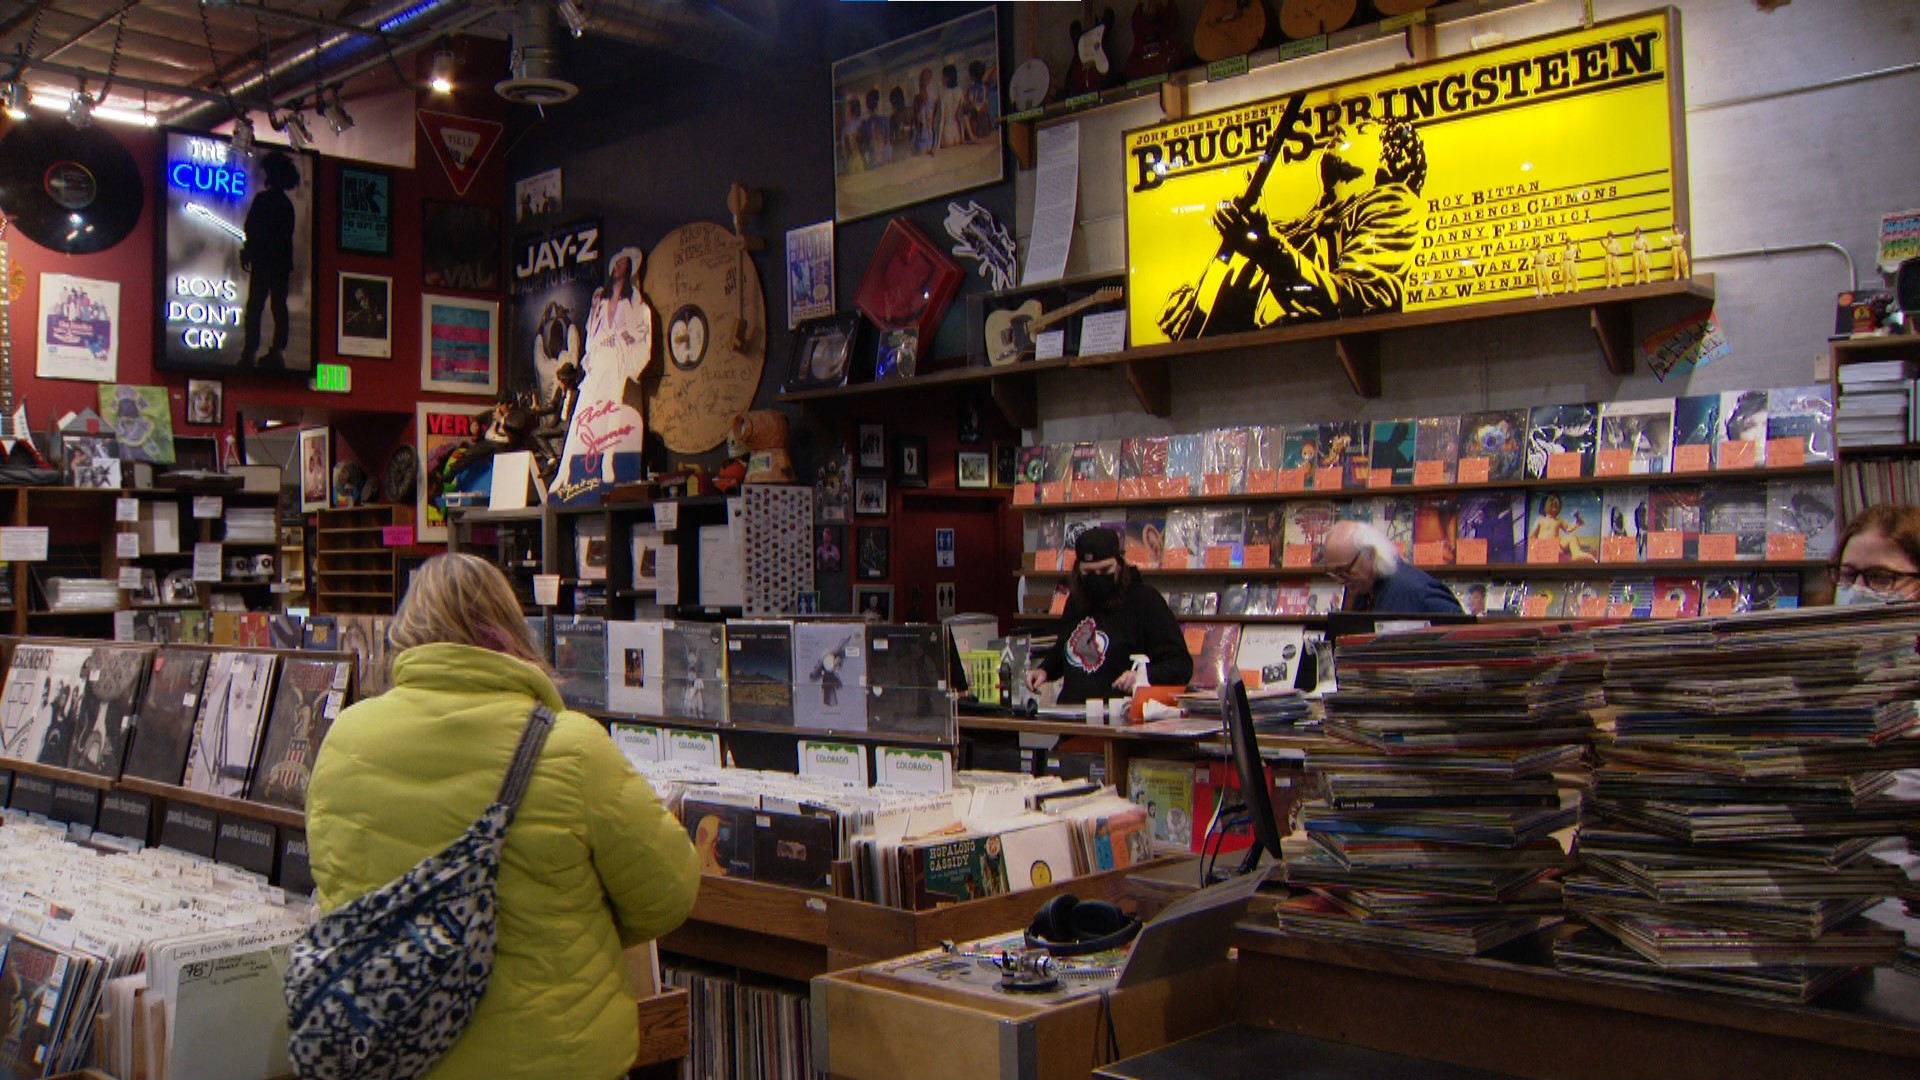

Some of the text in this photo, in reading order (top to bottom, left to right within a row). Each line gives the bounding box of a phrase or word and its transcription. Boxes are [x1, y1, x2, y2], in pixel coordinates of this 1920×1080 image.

[1131, 31, 1659, 193] BRUCE SPRINGSTEEN
[1136, 103, 1286, 146] JOHN SCHER PRESENTS
[189, 140, 227, 164] THE
[447, 133, 474, 146] YIELD
[172, 163, 246, 196] CURE
[1425, 185, 1617, 231] CLARENCE CLEMONS
[1427, 181, 1539, 213] ROY BITTAN
[1421, 209, 1590, 249] DANNY FEDERICI
[516, 228, 599, 278] JAY-Z
[1414, 231, 1567, 268] GARRY TALLENT
[1408, 266, 1467, 287] STEVE
[1474, 259, 1511, 277] VAN
[174, 276, 237, 301] BOYS
[1405, 270, 1560, 304] MAX WEINBEG
[167, 301, 244, 326] DON'T
[183, 328, 228, 350] CRY
[321, 365, 346, 390] EXIT
[428, 412, 475, 436] VER
[576, 399, 621, 437] Rick
[580, 424, 635, 474] James
[624, 735, 650, 746] COLORADO
[678, 740, 706, 751] COLORADO
[815, 753, 849, 766] COLORADO
[895, 760, 933, 772] COLORADO
[1340, 801, 1375, 810] Love Songs
[166, 810, 213, 832] punk/hardcore
[221, 823, 272, 848] punk/hardcore
[929, 840, 977, 860] HOPALONG
[929, 855, 970, 872] CASSIDY
